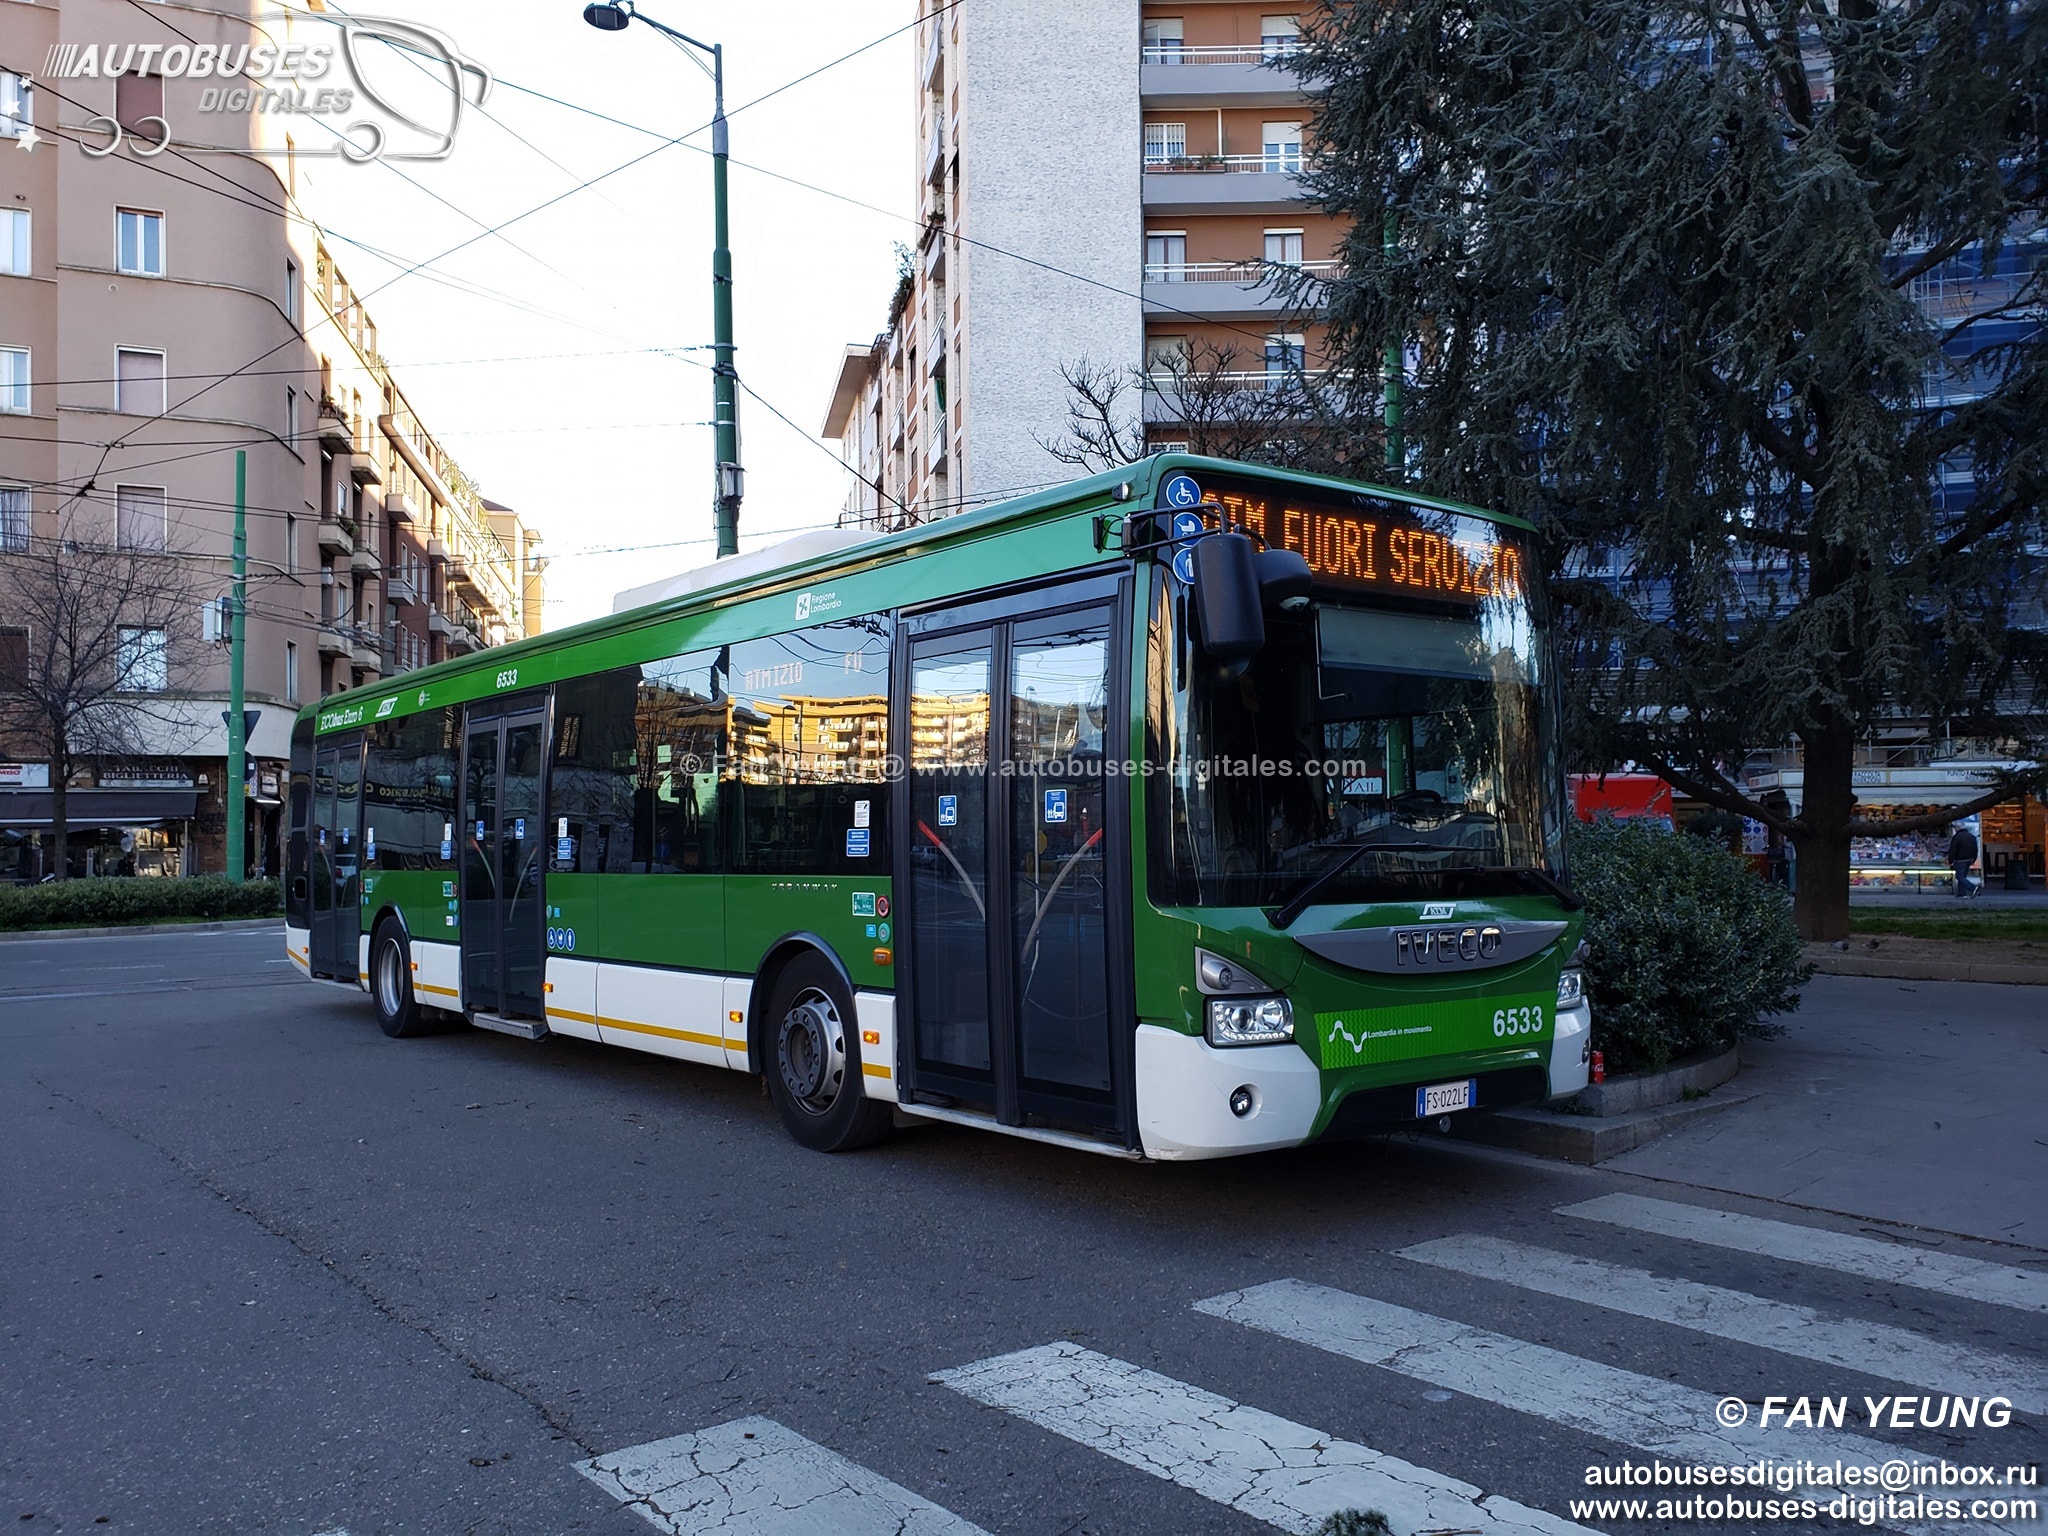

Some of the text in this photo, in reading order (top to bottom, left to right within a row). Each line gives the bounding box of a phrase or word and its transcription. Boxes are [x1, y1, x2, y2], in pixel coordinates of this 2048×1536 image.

[1284, 509, 1377, 580] FUORI
[1390, 529, 1519, 599] SERVIZIO
[810, 600, 842, 613] Lombardia
[811, 592, 836, 604] Regione
[496, 669, 518, 689] 6533
[358, 705, 364, 722] 6
[1396, 927, 1501, 966] IVECO
[1493, 1005, 1543, 1037] 6533
[1368, 1028, 1397, 1038] Lombardia
